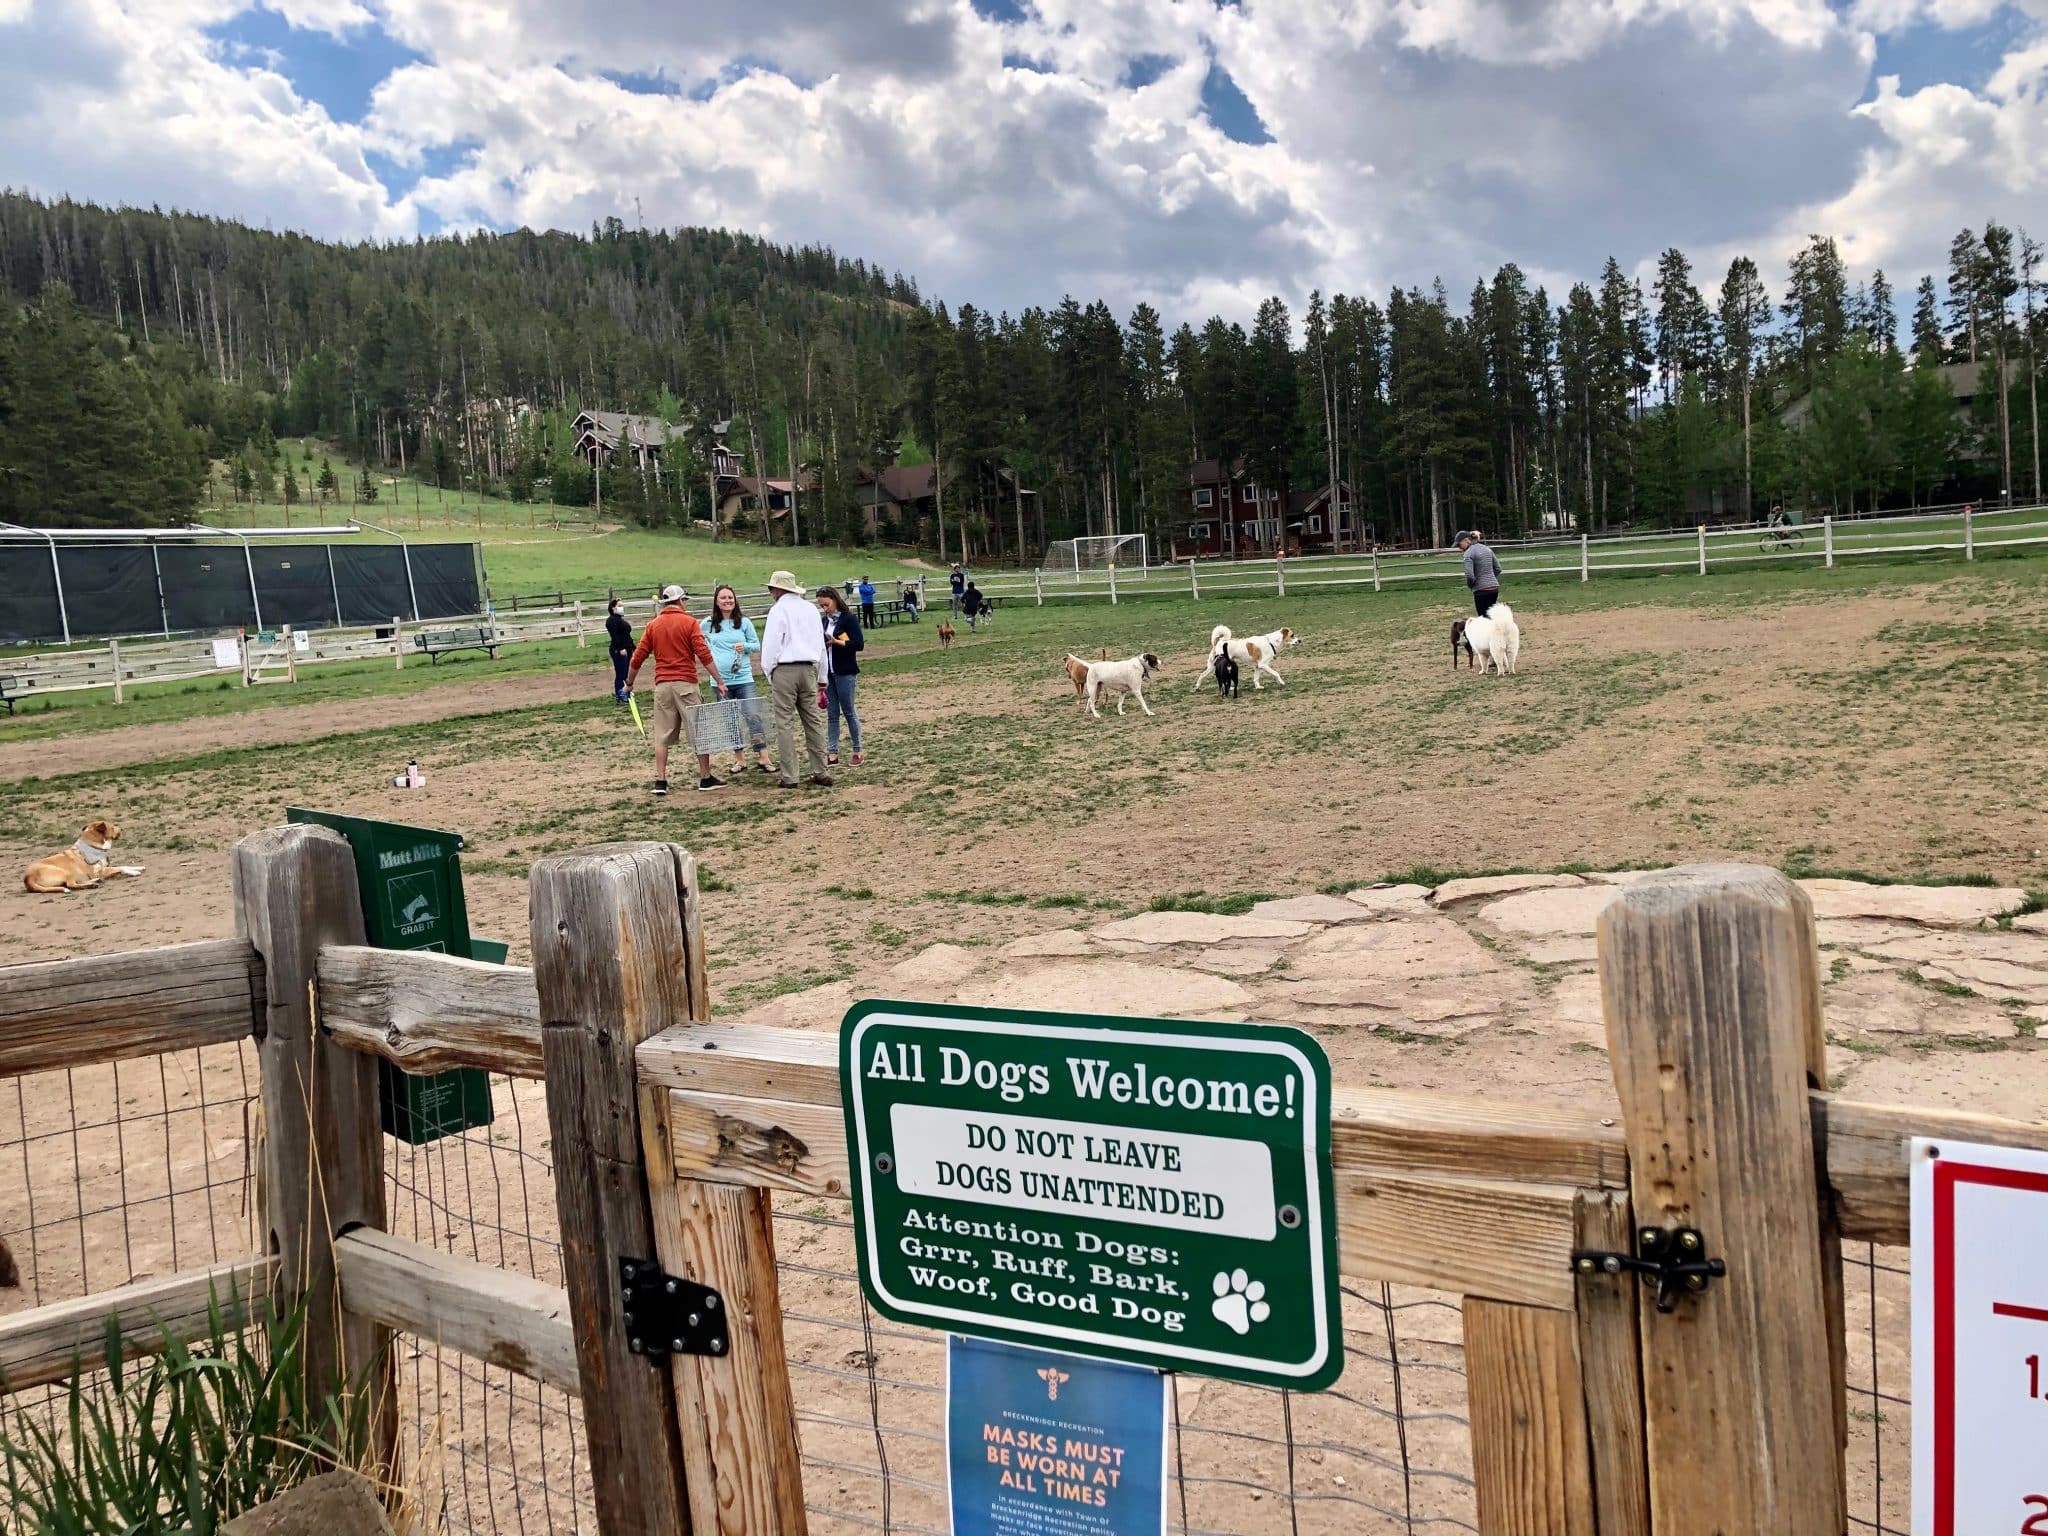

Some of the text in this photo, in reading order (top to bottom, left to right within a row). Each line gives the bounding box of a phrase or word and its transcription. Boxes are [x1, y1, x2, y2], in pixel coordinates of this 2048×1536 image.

[378, 843, 442, 869] Mutt Mitt
[400, 920, 435, 936] GRAB IT
[867, 1041, 1296, 1119] All Dogs Welcome!
[966, 1123, 1181, 1172] DO NOT LEAVE
[936, 1161, 1225, 1221] DOGS UNATTENDED
[903, 1208, 1180, 1266] Attention Dogs:
[900, 1238, 1190, 1301] Grrr, Ruff, Bark,
[908, 1266, 1186, 1332] Woof, Good Dog
[1002, 1410, 1104, 1435] BRECKENRIDGE RECREATION
[983, 1423, 1125, 1467] MASKS MUST
[987, 1445, 1120, 1489] BE WORN AT
[1000, 1469, 1106, 1507] ALL TIMES
[1055, 1507, 1074, 1518] with
